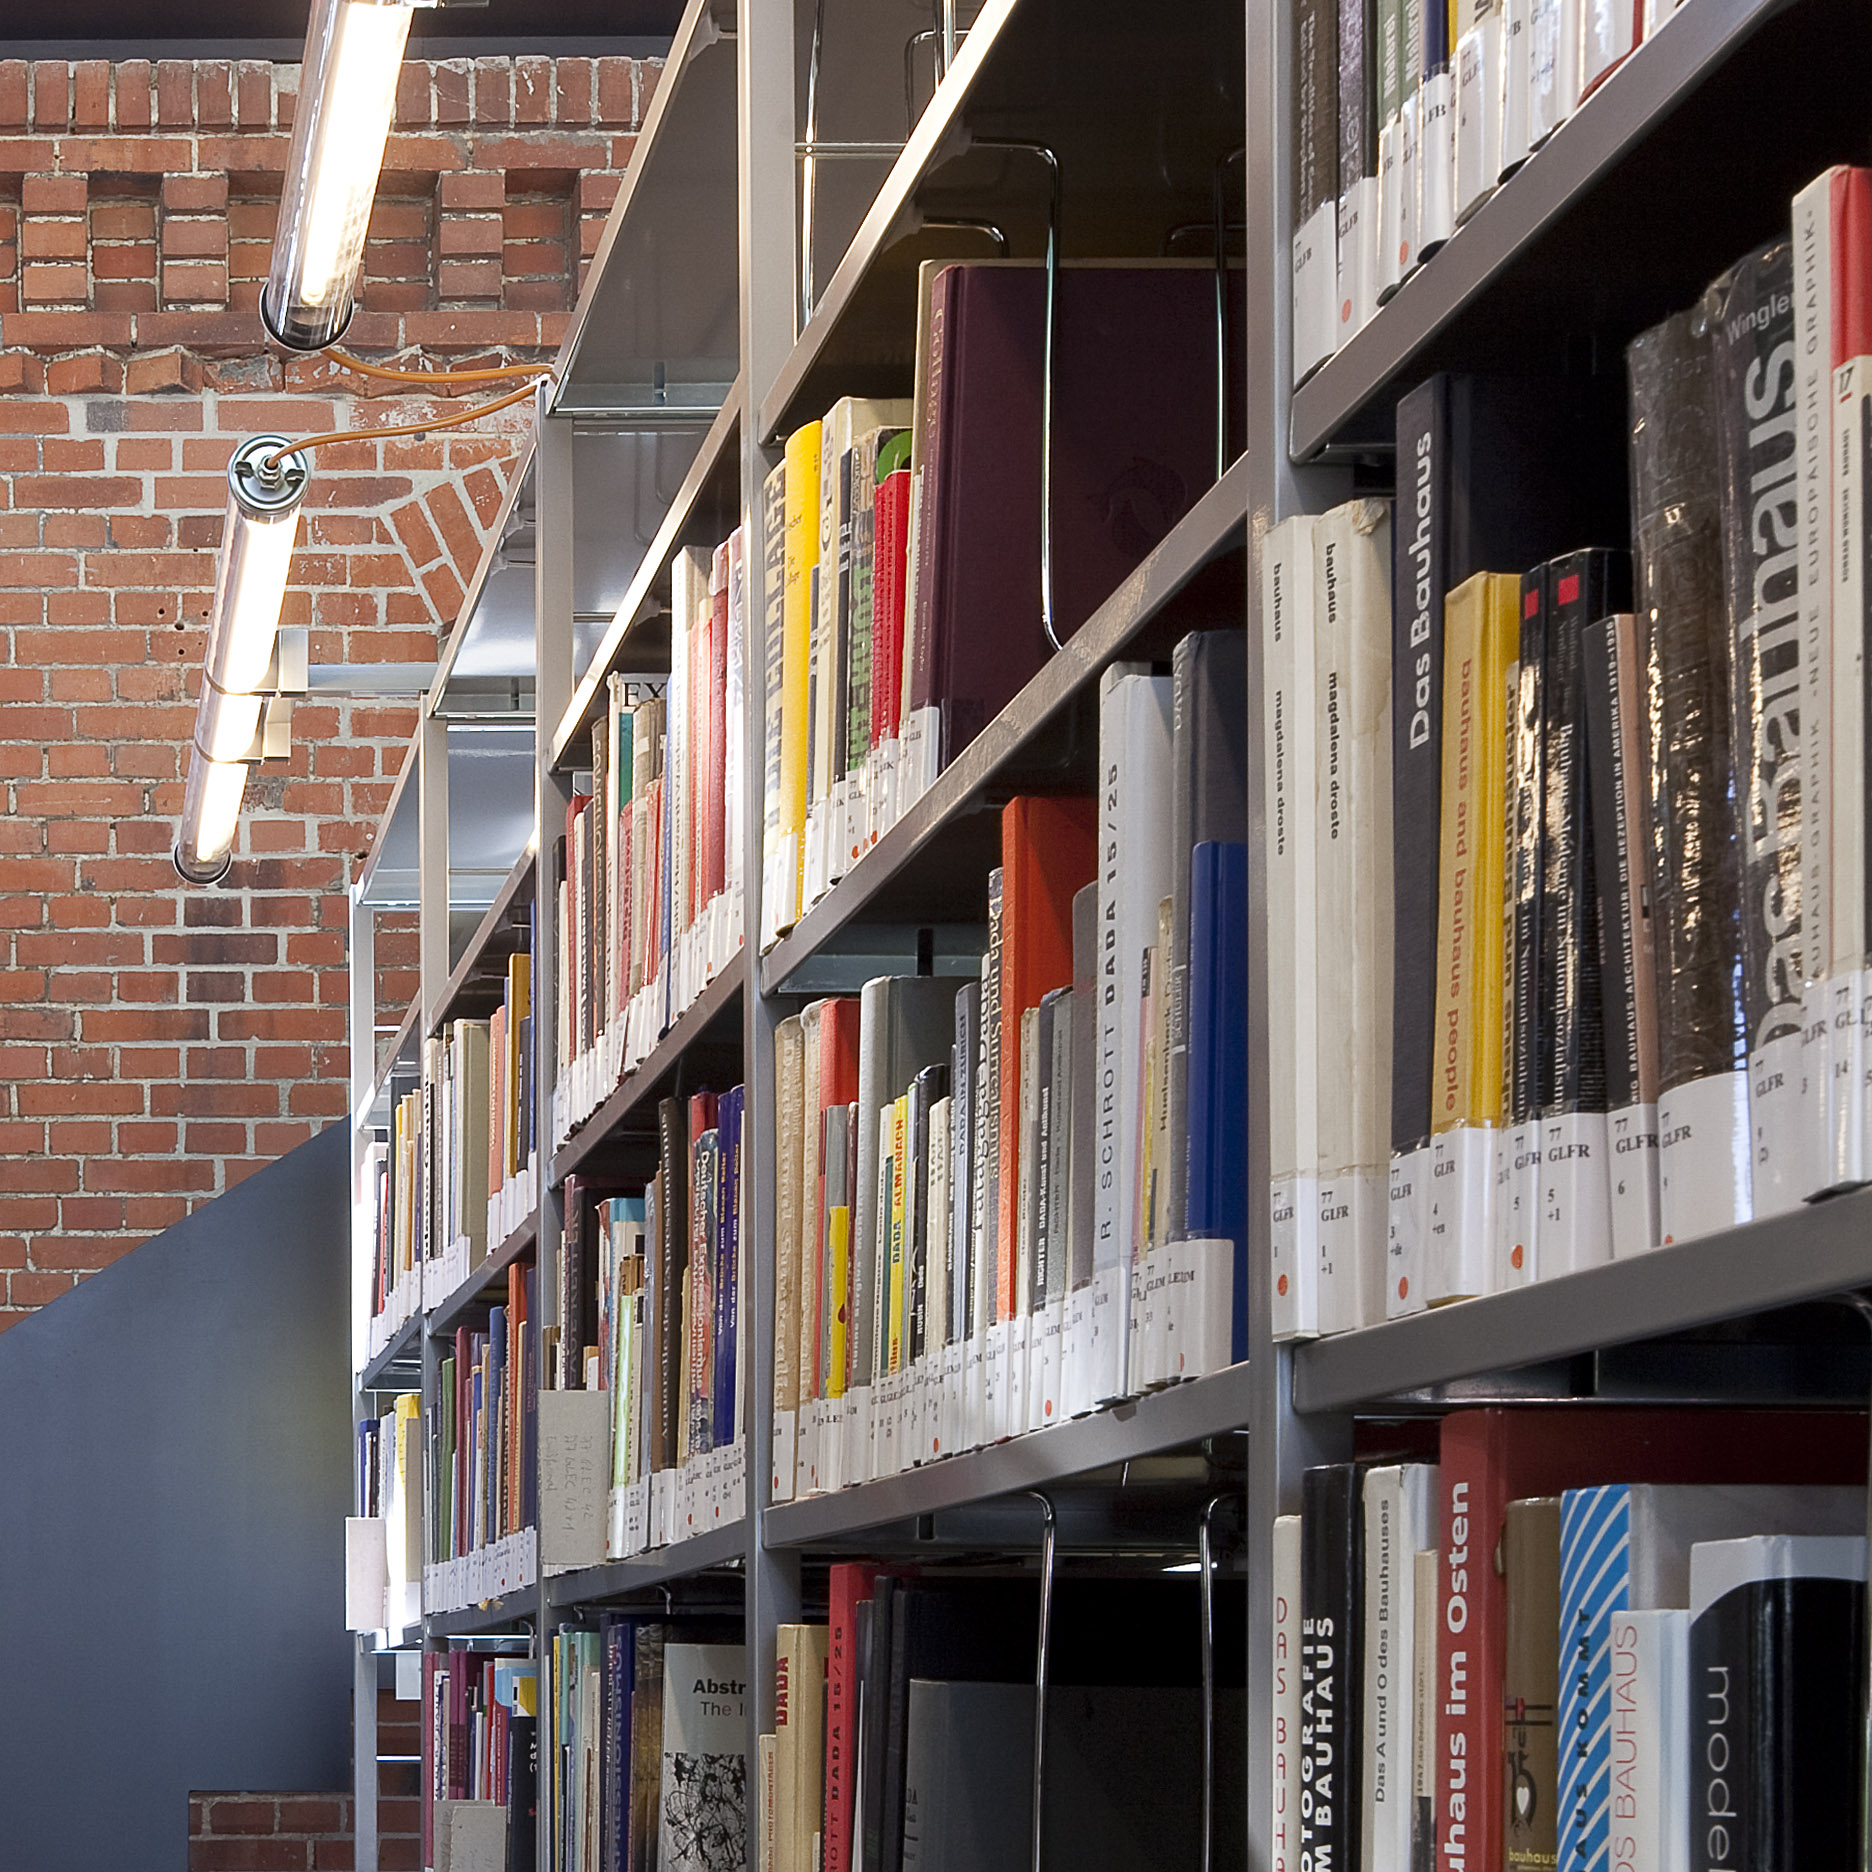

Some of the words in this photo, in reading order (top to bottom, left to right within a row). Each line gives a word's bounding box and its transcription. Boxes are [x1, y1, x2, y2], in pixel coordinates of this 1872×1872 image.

[1383, 12, 1397, 99] Malerei
[764, 467, 787, 684] COLLAGE
[1406, 429, 1436, 644] Bauhaus
[1273, 563, 1283, 643] bauhaus
[1325, 543, 1338, 624] bauhaus
[1739, 340, 1803, 864] Bauhaus
[1274, 690, 1285, 793] magdalena
[1327, 672, 1341, 776] magdalena
[1408, 650, 1435, 752] Das
[1455, 657, 1475, 792] bauhaus
[1609, 696, 1623, 758] AMERIKA
[1276, 796, 1286, 856] droste
[1329, 780, 1341, 840] droste
[1451, 800, 1473, 862] and
[1613, 779, 1626, 856] REZEPTION
[1104, 900, 1118, 1006] DADA
[1447, 866, 1469, 996] bauhaus
[1620, 886, 1639, 1072] BAUHAUS-ARCHITEKTUR:
[1443, 1004, 1466, 1113] people
[1099, 1024, 1115, 1190] SCHROTT
[1614, 1117, 1629, 1133] 77
[1615, 1132, 1659, 1154] GLFR
[659, 1113, 672, 1290] Expressionismus
[893, 1118, 905, 1207] ALMANACH
[1038, 1164, 1049, 1230] DADA-Kunst
[892, 1221, 903, 1264] DADA
[1037, 1237, 1047, 1286] RICHTER
[661, 1296, 671, 1332] des
[1378, 1498, 1390, 1622] Bauhauses
[1445, 1479, 1472, 1638] Osten
[1377, 1628, 1389, 1669] des
[1442, 1648, 1470, 1718] im
[1572, 1608, 1592, 1760] KOMMT
[700, 1701, 733, 1717] The
[775, 1655, 790, 1727] DADA
[1313, 1616, 1335, 1830] BAUHAUS
[1376, 1694, 1387, 1737] und
[1612, 1623, 1639, 1820] BAUHAUS
[828, 1724, 841, 1801] DADA
[1374, 1762, 1387, 1803] Das
